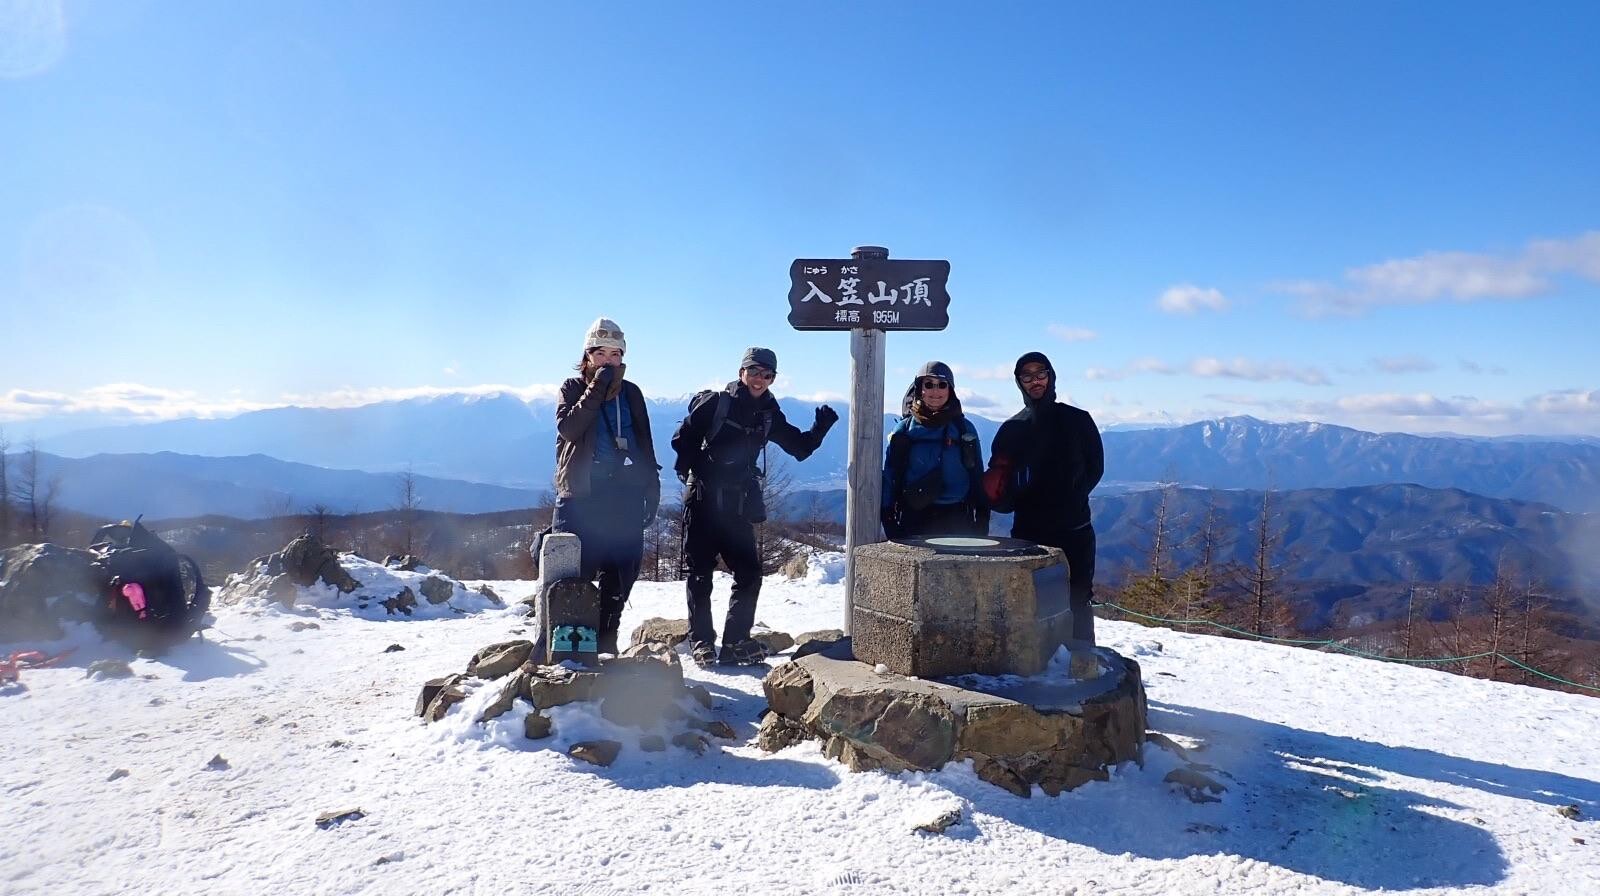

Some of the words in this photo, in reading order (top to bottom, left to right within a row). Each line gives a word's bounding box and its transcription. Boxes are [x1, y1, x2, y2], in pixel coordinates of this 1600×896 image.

[841, 266, 859, 275] かさ
[801, 277, 932, 307] 入笠山頂
[834, 310, 860, 323] 標高
[872, 310, 900, 324] 1955M
